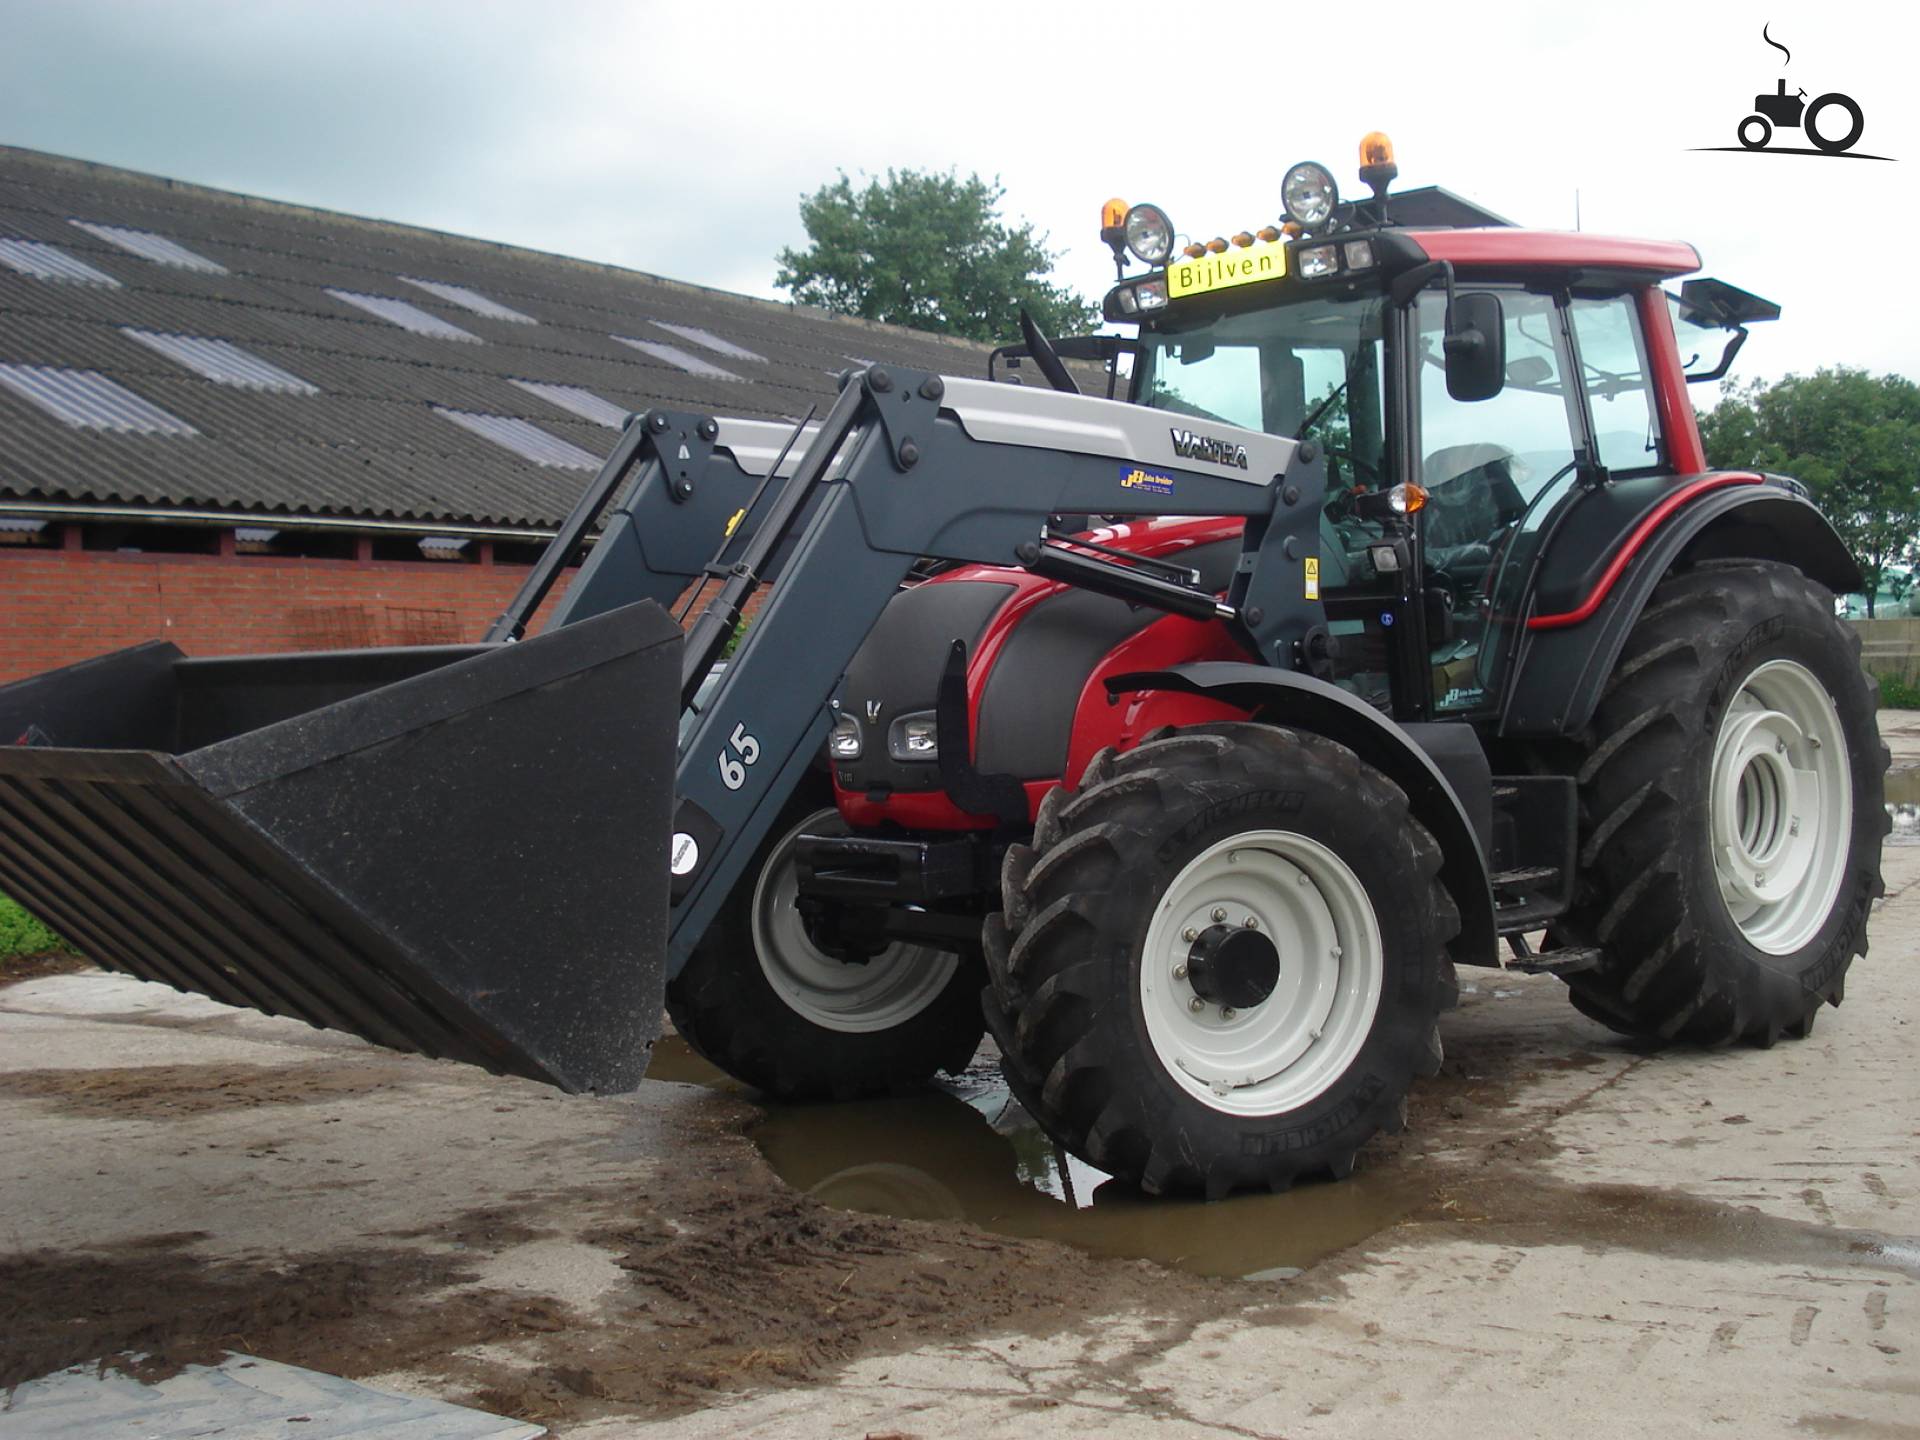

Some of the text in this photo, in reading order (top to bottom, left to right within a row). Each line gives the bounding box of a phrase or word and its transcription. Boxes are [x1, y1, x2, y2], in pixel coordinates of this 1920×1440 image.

[1180, 255, 1272, 288] Bijlven
[1170, 427, 1248, 470] VALTRA
[718, 720, 761, 791] 65
